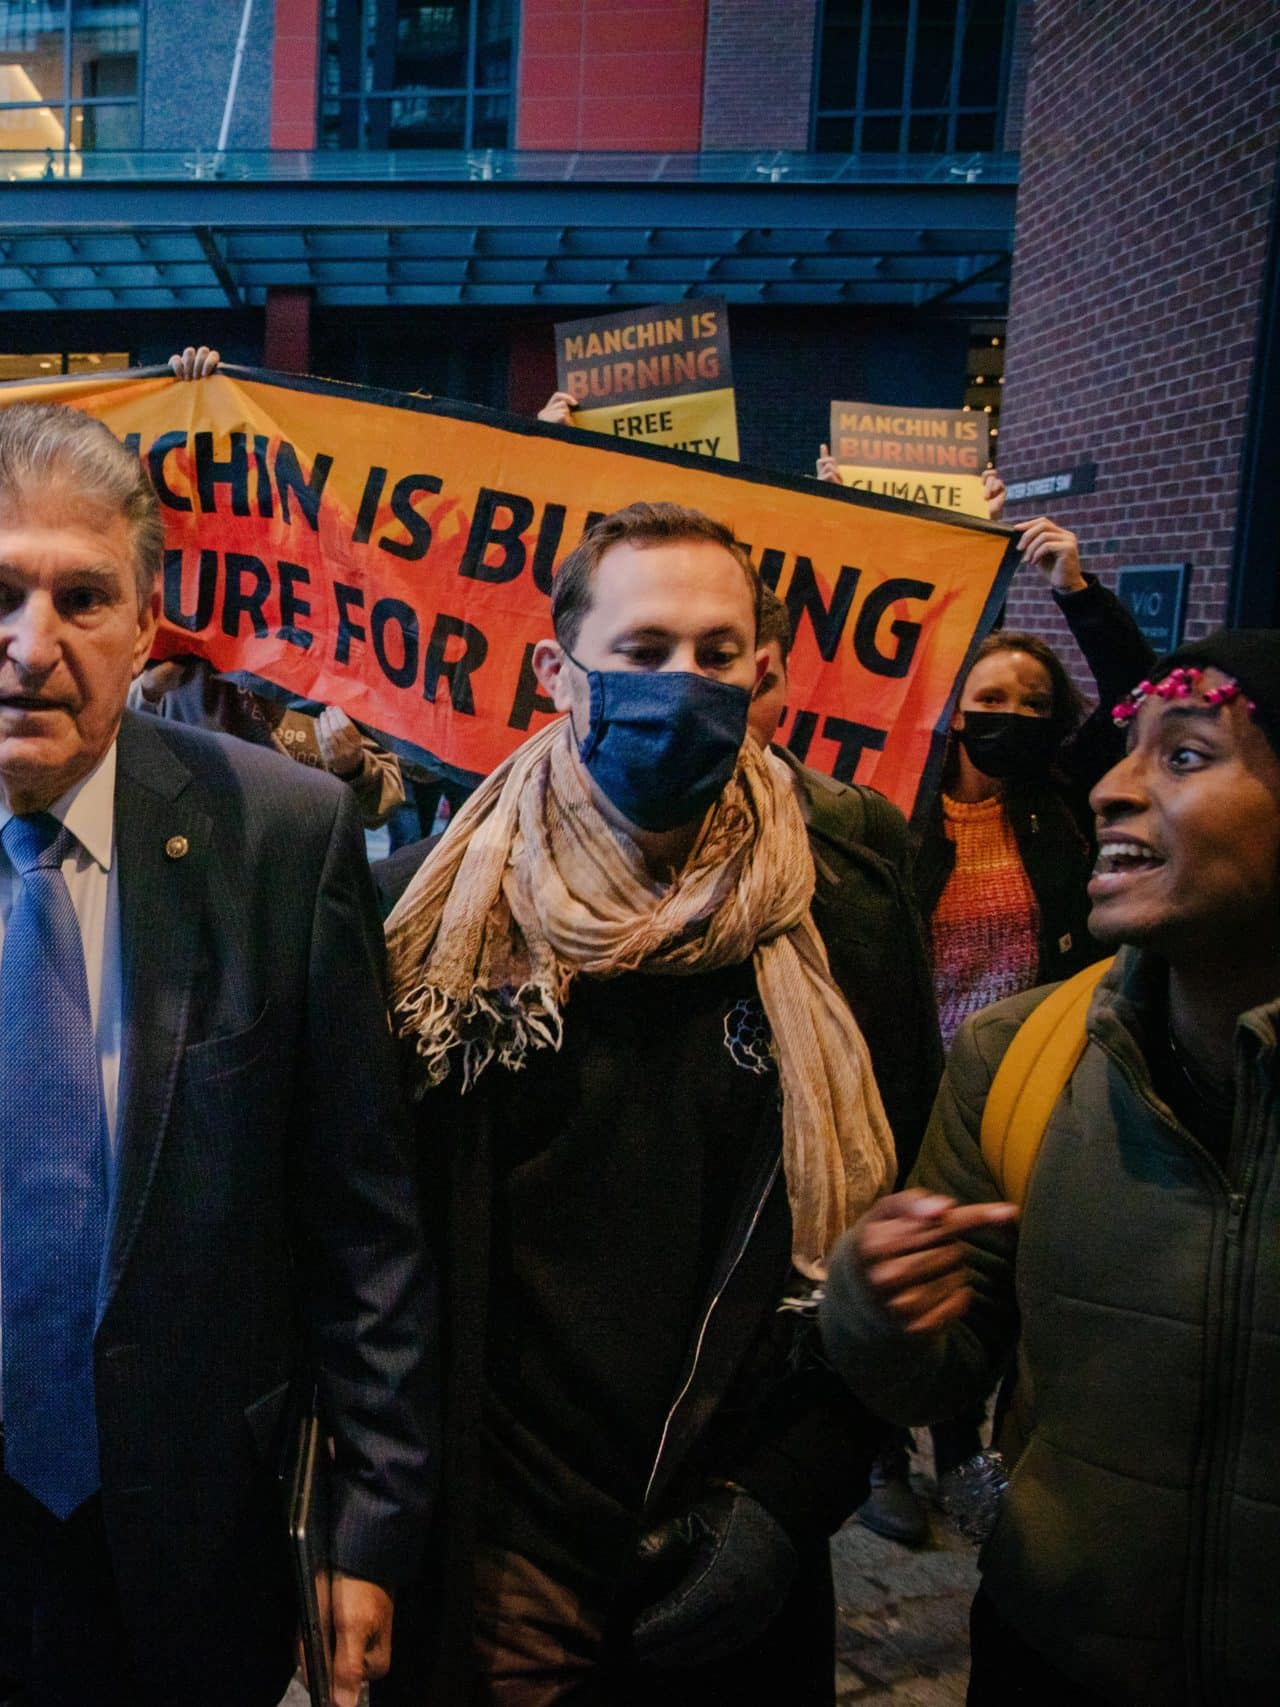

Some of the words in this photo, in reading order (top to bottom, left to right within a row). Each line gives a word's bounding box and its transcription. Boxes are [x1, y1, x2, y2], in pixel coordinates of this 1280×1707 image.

[564, 317, 683, 361] MANCHIN
[691, 311, 718, 339] IS
[567, 346, 720, 400] BURNING
[613, 410, 673, 437] FREE
[839, 413, 947, 438] MANCHIN
[954, 421, 978, 441] IS
[839, 437, 979, 468] BURNING
[124, 430, 334, 532] CHIN
[352, 465, 443, 561] IS
[163, 549, 315, 650] URE
[333, 581, 489, 716] FOR
